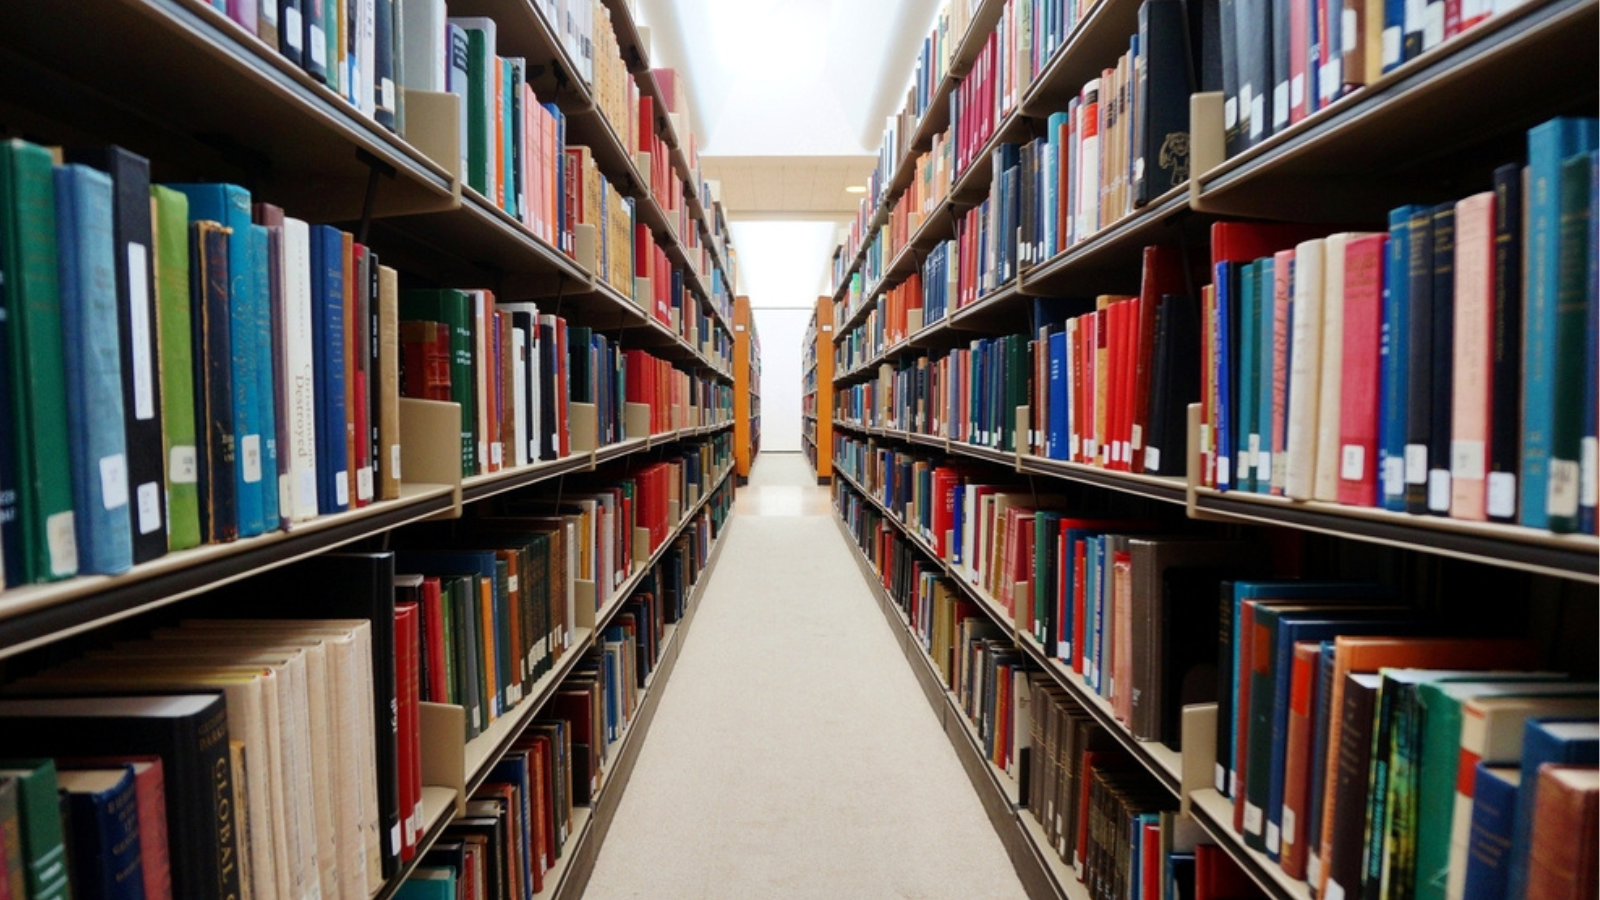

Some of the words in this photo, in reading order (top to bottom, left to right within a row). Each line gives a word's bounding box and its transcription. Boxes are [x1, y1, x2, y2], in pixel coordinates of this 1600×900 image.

[295, 375, 308, 458] Destroyed
[304, 364, 314, 468] Christendom
[215, 757, 234, 884] GLOBAL
